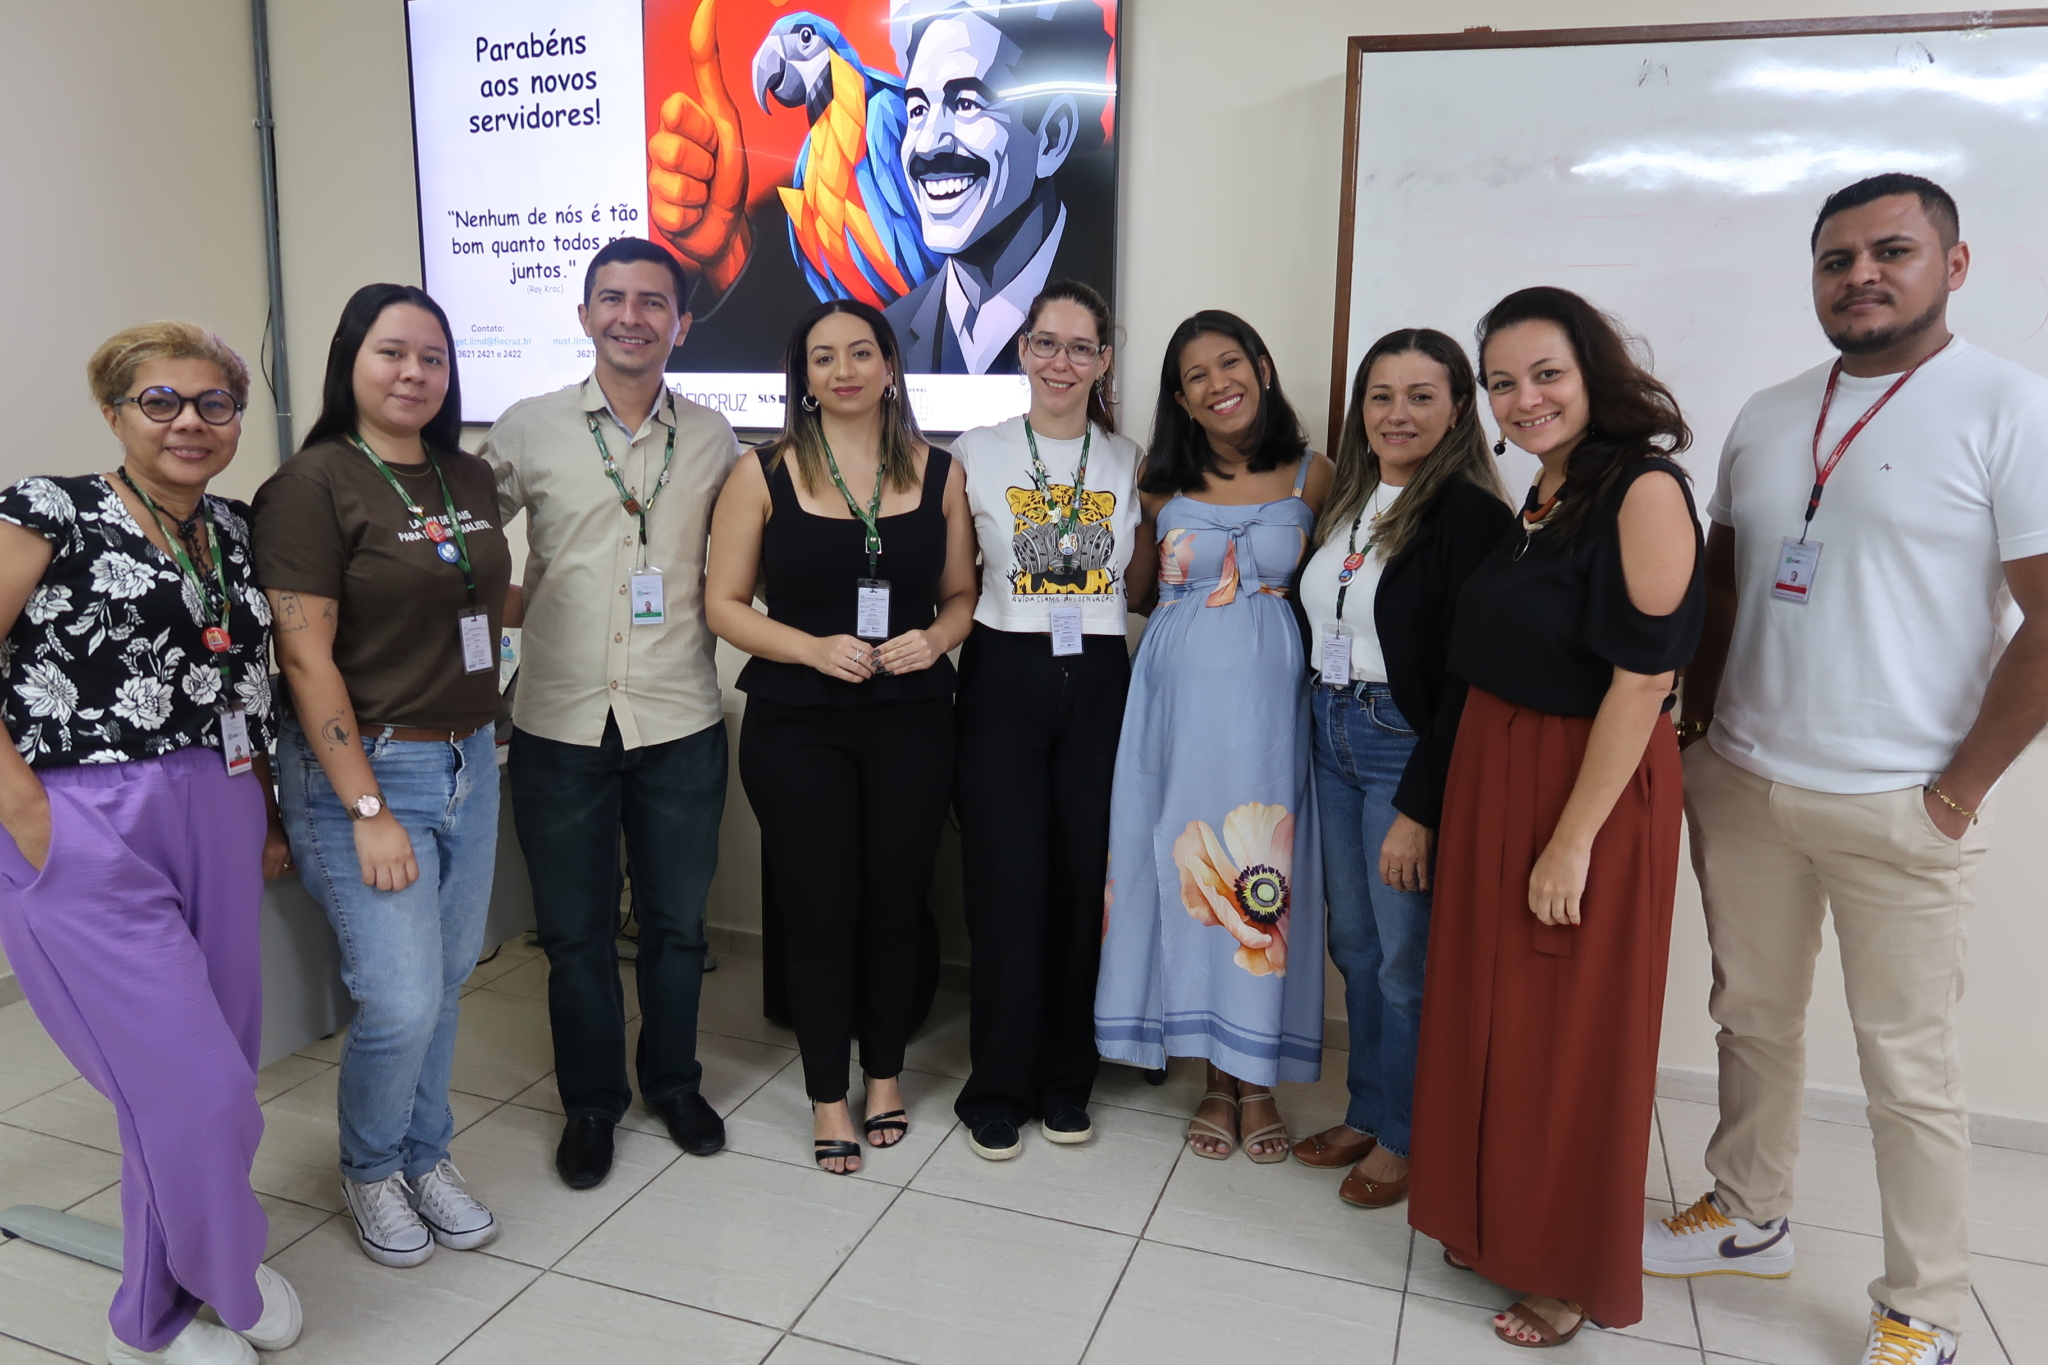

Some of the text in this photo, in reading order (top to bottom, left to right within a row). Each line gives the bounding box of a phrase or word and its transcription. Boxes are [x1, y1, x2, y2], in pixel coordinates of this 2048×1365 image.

[476, 28, 587, 63] Parabéns
[480, 70, 597, 98] aos novos
[469, 98, 601, 134] servidores!
[527, 207, 548, 225] de
[555, 204, 583, 224] nós
[591, 203, 601, 223] é
[609, 203, 639, 222] tão
[451, 237, 485, 255] bom
[491, 236, 546, 259] quanto
[553, 232, 600, 251] todos
[509, 259, 577, 286] juntos."
[526, 284, 564, 296] (Ray Kroc)
[470, 324, 505, 333] Contato:
[455, 337, 532, 347] get.ilmd@fiocruz.br
[553, 336, 592, 345] nust.ilmd
[457, 350, 475, 359] 3621
[477, 350, 495, 359] 2421
[503, 350, 522, 359] 2422
[576, 350, 595, 359] 3621
[757, 394, 777, 404] SUS
[397, 530, 424, 542] PARA
